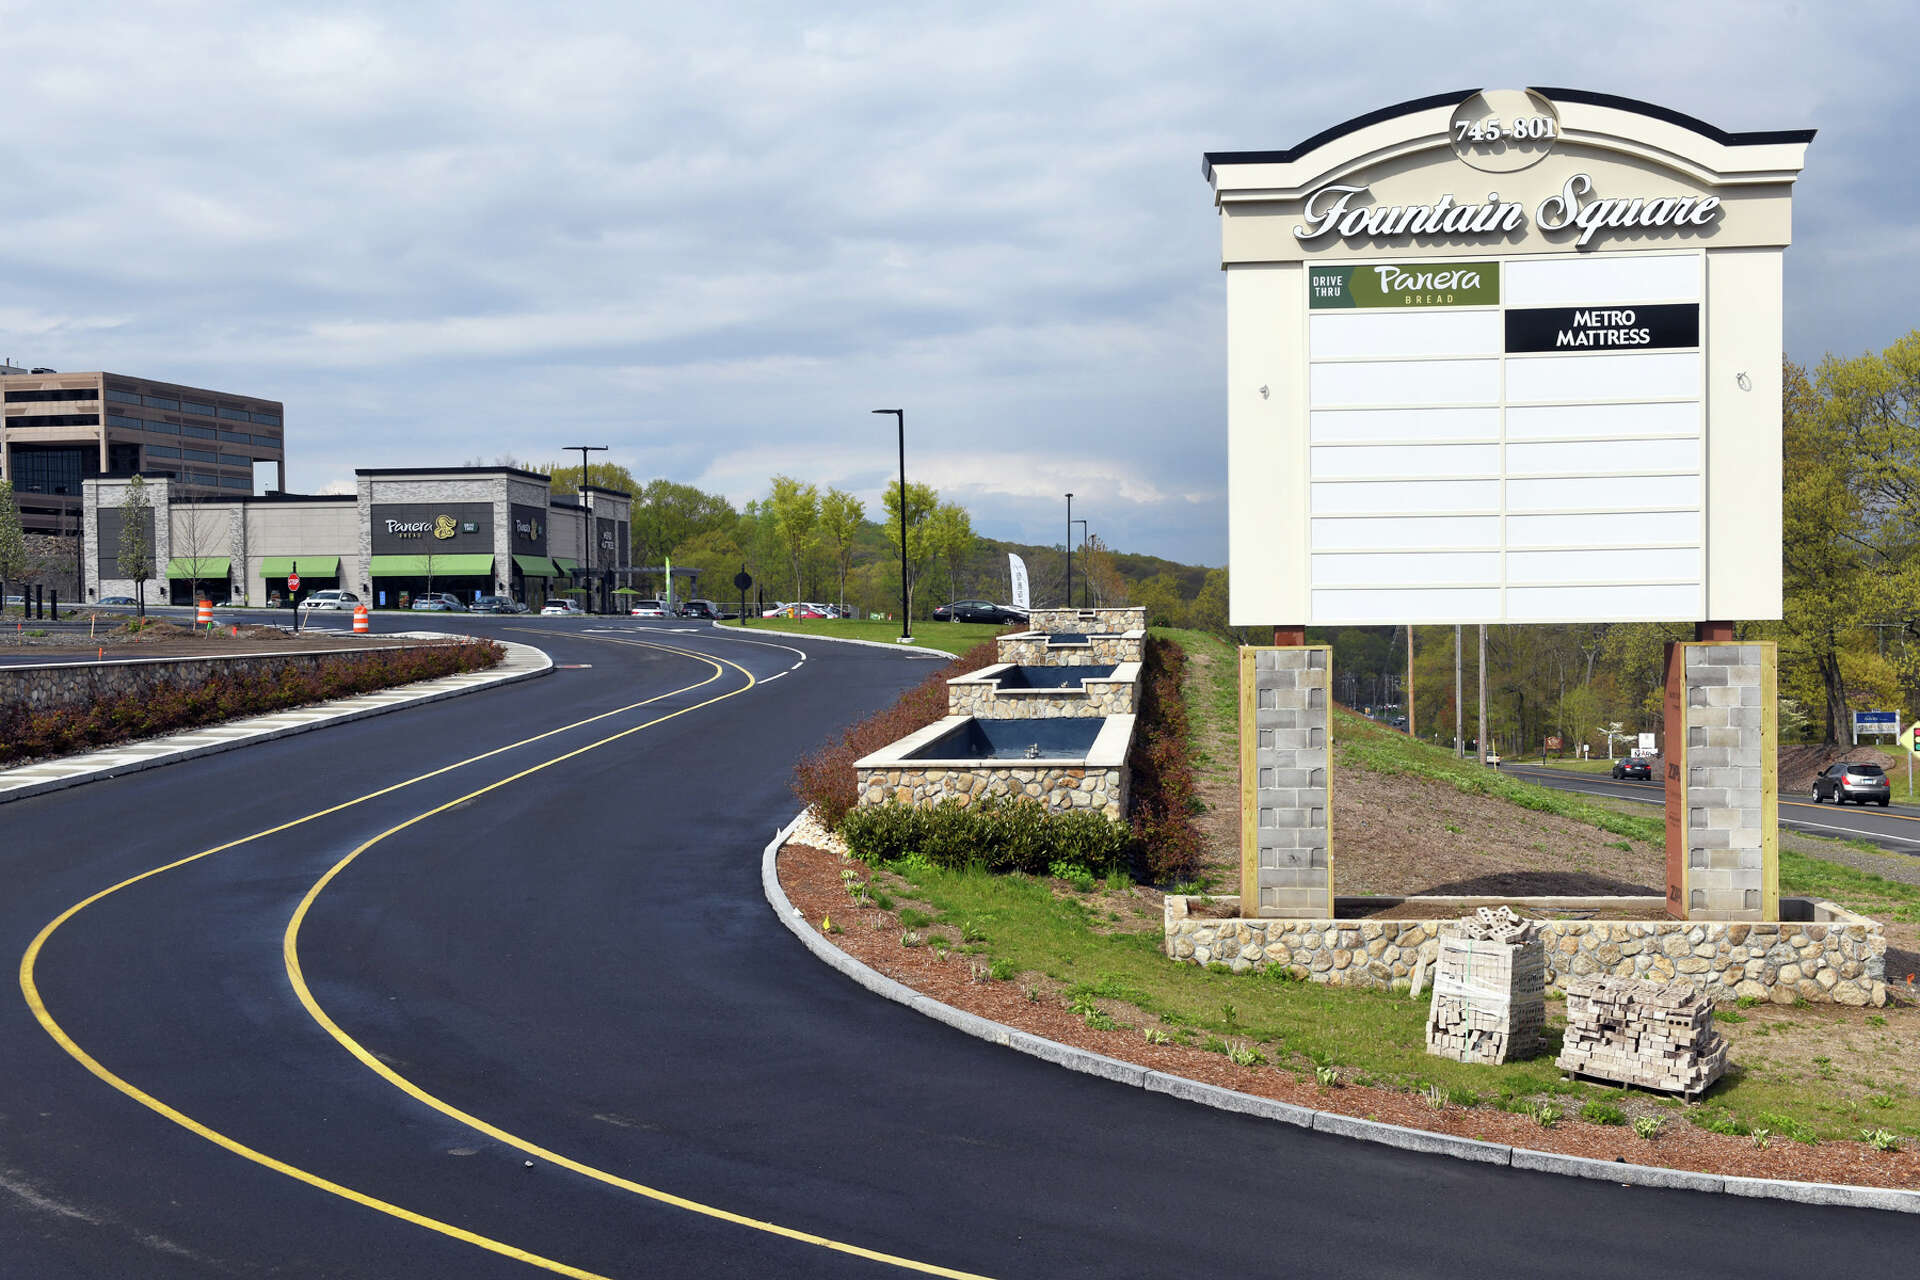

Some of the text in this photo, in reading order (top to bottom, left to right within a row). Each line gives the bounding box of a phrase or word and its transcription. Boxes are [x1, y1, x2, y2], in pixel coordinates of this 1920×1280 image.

[1455, 116, 1557, 143] 745-801
[1293, 173, 1721, 248] Fountain Square
[1313, 275, 1343, 287] DRIVE
[1374, 265, 1481, 293] Panera
[1315, 287, 1341, 297] THRU
[1405, 295, 1454, 305] BREAD
[1573, 310, 1636, 327] METRO
[1556, 328, 1650, 347] MATTRESS
[385, 519, 433, 534] Panera
